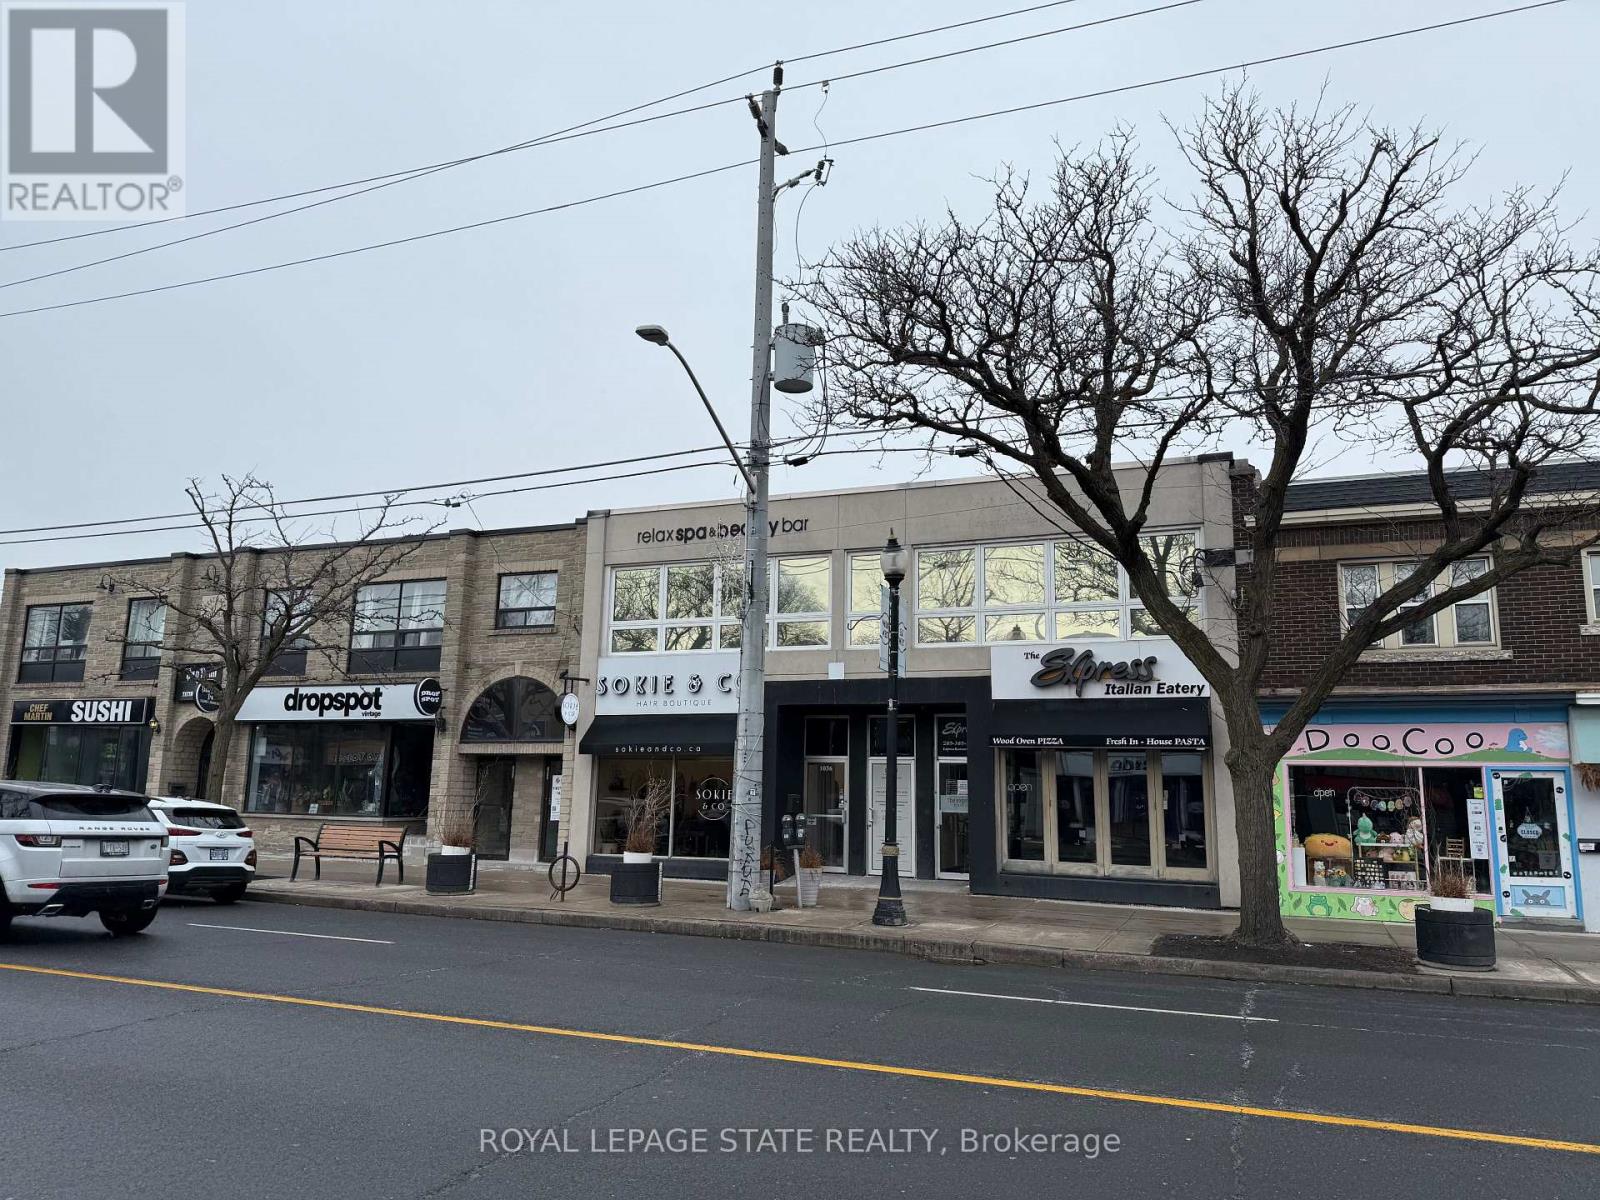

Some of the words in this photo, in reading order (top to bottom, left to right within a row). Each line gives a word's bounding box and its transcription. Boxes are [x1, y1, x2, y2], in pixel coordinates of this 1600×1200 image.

[637, 527, 674, 545] relax
[676, 524, 707, 544] spa
[782, 517, 809, 533] bar
[1023, 651, 1040, 660] The
[1030, 647, 1158, 698] Express
[596, 674, 674, 696] SOKIE
[687, 673, 702, 694] &
[716, 672, 741, 693] C
[1104, 683, 1151, 696] Italian
[1156, 682, 1206, 697] Eatery
[284, 687, 383, 717] dropspot
[663, 699, 712, 707] BOUTIQUE
[29, 703, 49, 713] CHEF
[70, 700, 132, 722] SUSHI
[23, 711, 53, 721] MARTIN
[361, 710, 382, 718] vintage
[992, 736, 1015, 745] Wood
[1016, 737, 1036, 745] Oven
[1037, 737, 1064, 745] PIZZA
[1106, 736, 1127, 745] Fresh
[1129, 737, 1139, 745] In
[1146, 737, 1173, 746] House
[1174, 738, 1205, 746] PASTA
[695, 788, 733, 800] SOKIE
[1313, 787, 1336, 801] open
[711, 802, 725, 811] CO
